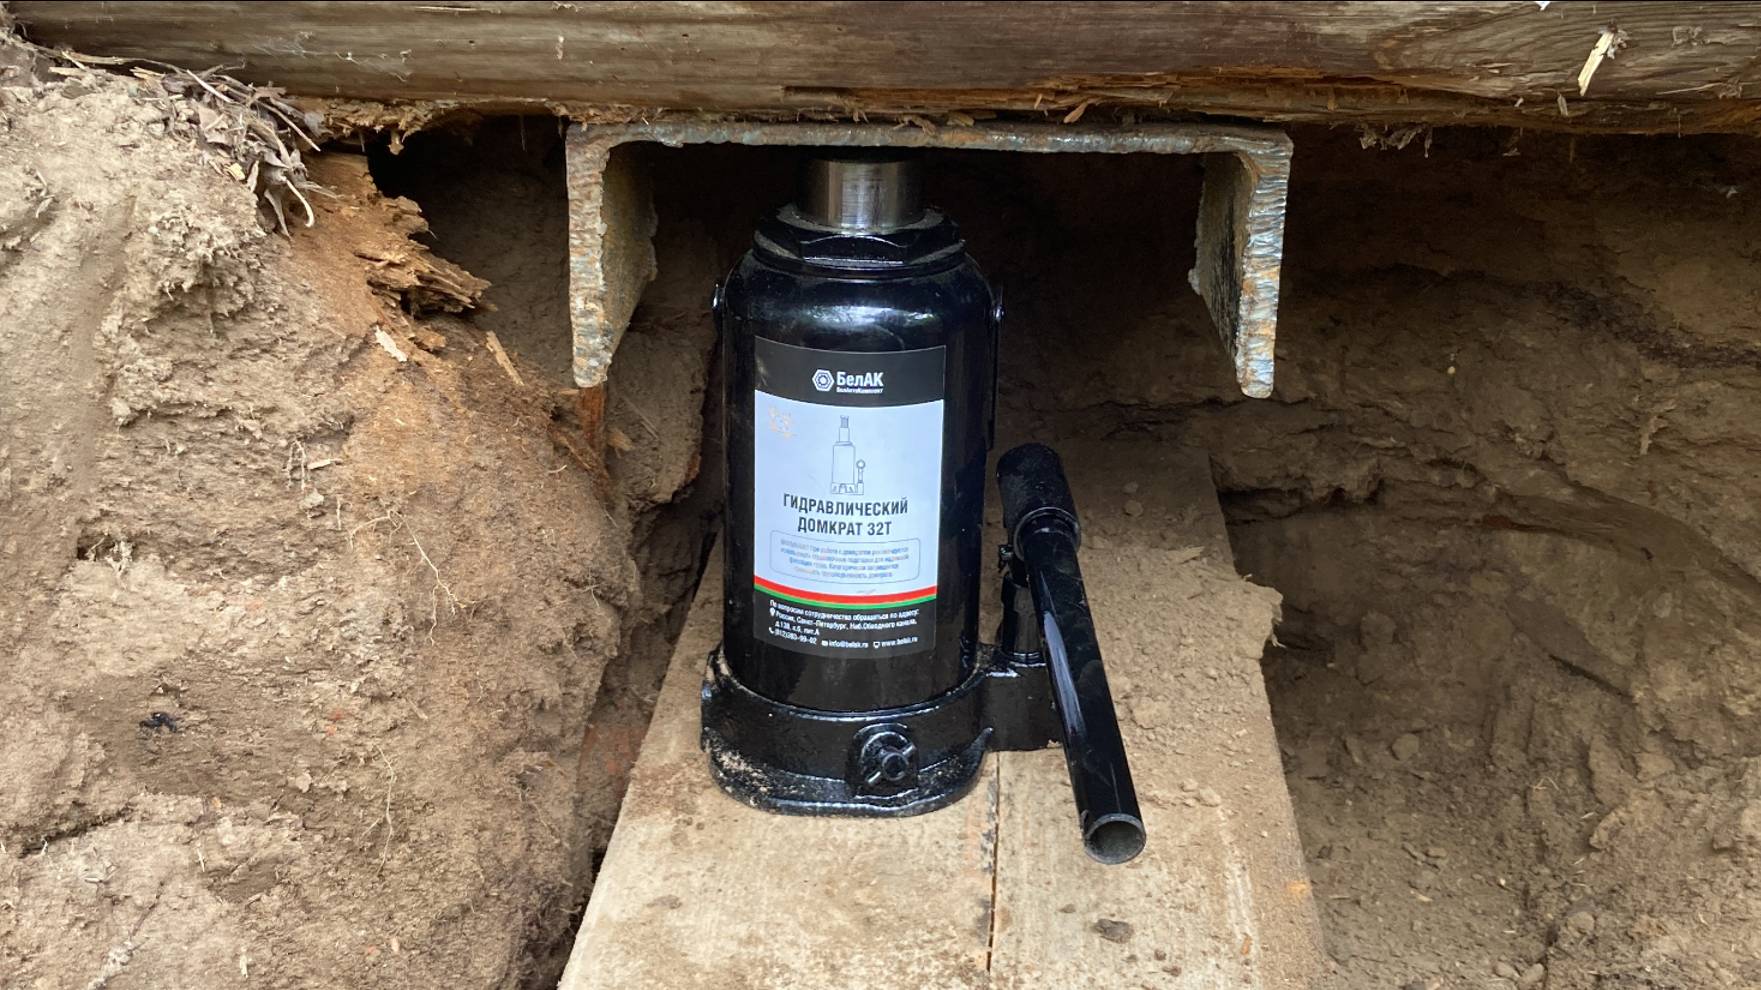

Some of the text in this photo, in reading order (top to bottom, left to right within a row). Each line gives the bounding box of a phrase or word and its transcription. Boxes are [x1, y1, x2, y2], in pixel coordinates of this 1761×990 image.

[837, 371, 884, 387] БелАК
[783, 493, 908, 516] ГИДРАВЛИЧЕСКИЙ
[797, 516, 863, 536] ДОМКРАТ
